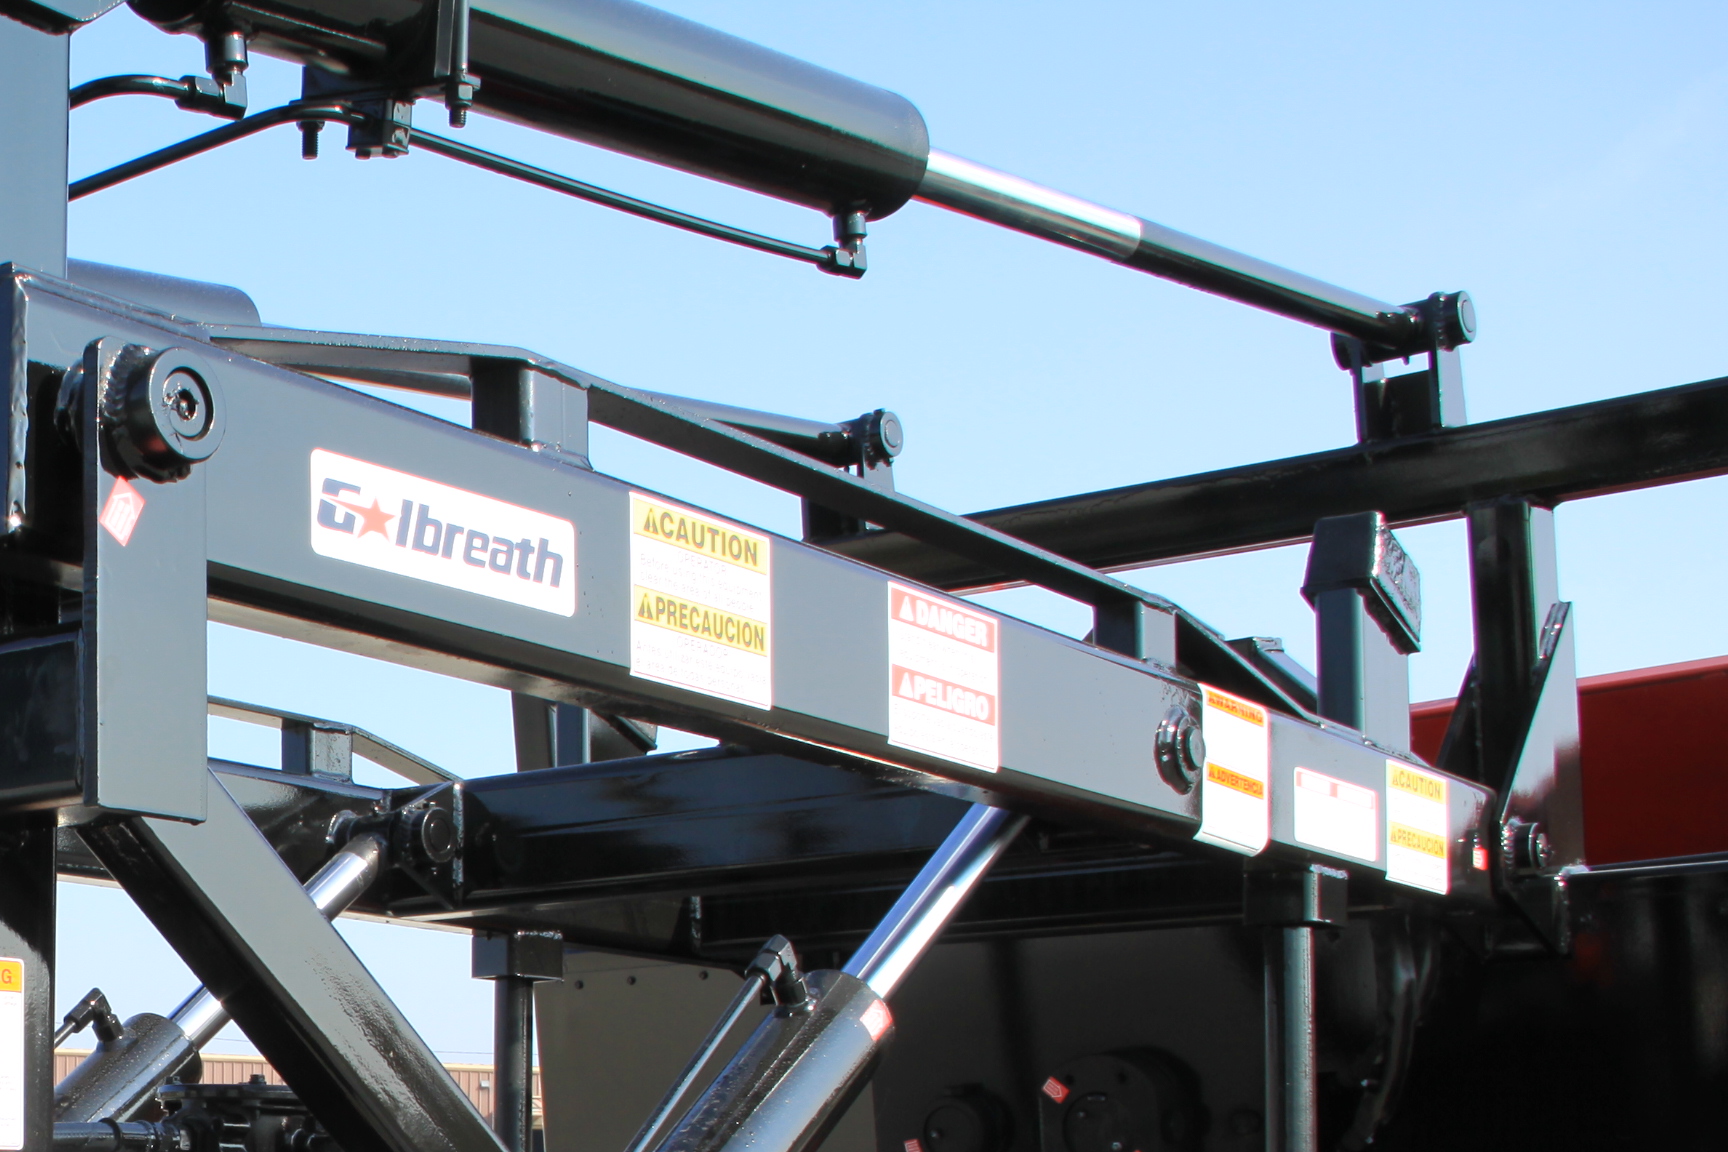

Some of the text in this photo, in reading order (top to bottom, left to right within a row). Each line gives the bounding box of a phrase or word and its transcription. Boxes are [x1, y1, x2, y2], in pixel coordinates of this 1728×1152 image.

[660, 511, 758, 567] CAUTION
[656, 596, 764, 651] PRECAUCION
[916, 600, 988, 647] DANGER
[914, 676, 989, 720] PELIGRO
[1399, 771, 1440, 799] CAUTION
[1398, 829, 1444, 856] PRECAUCION
